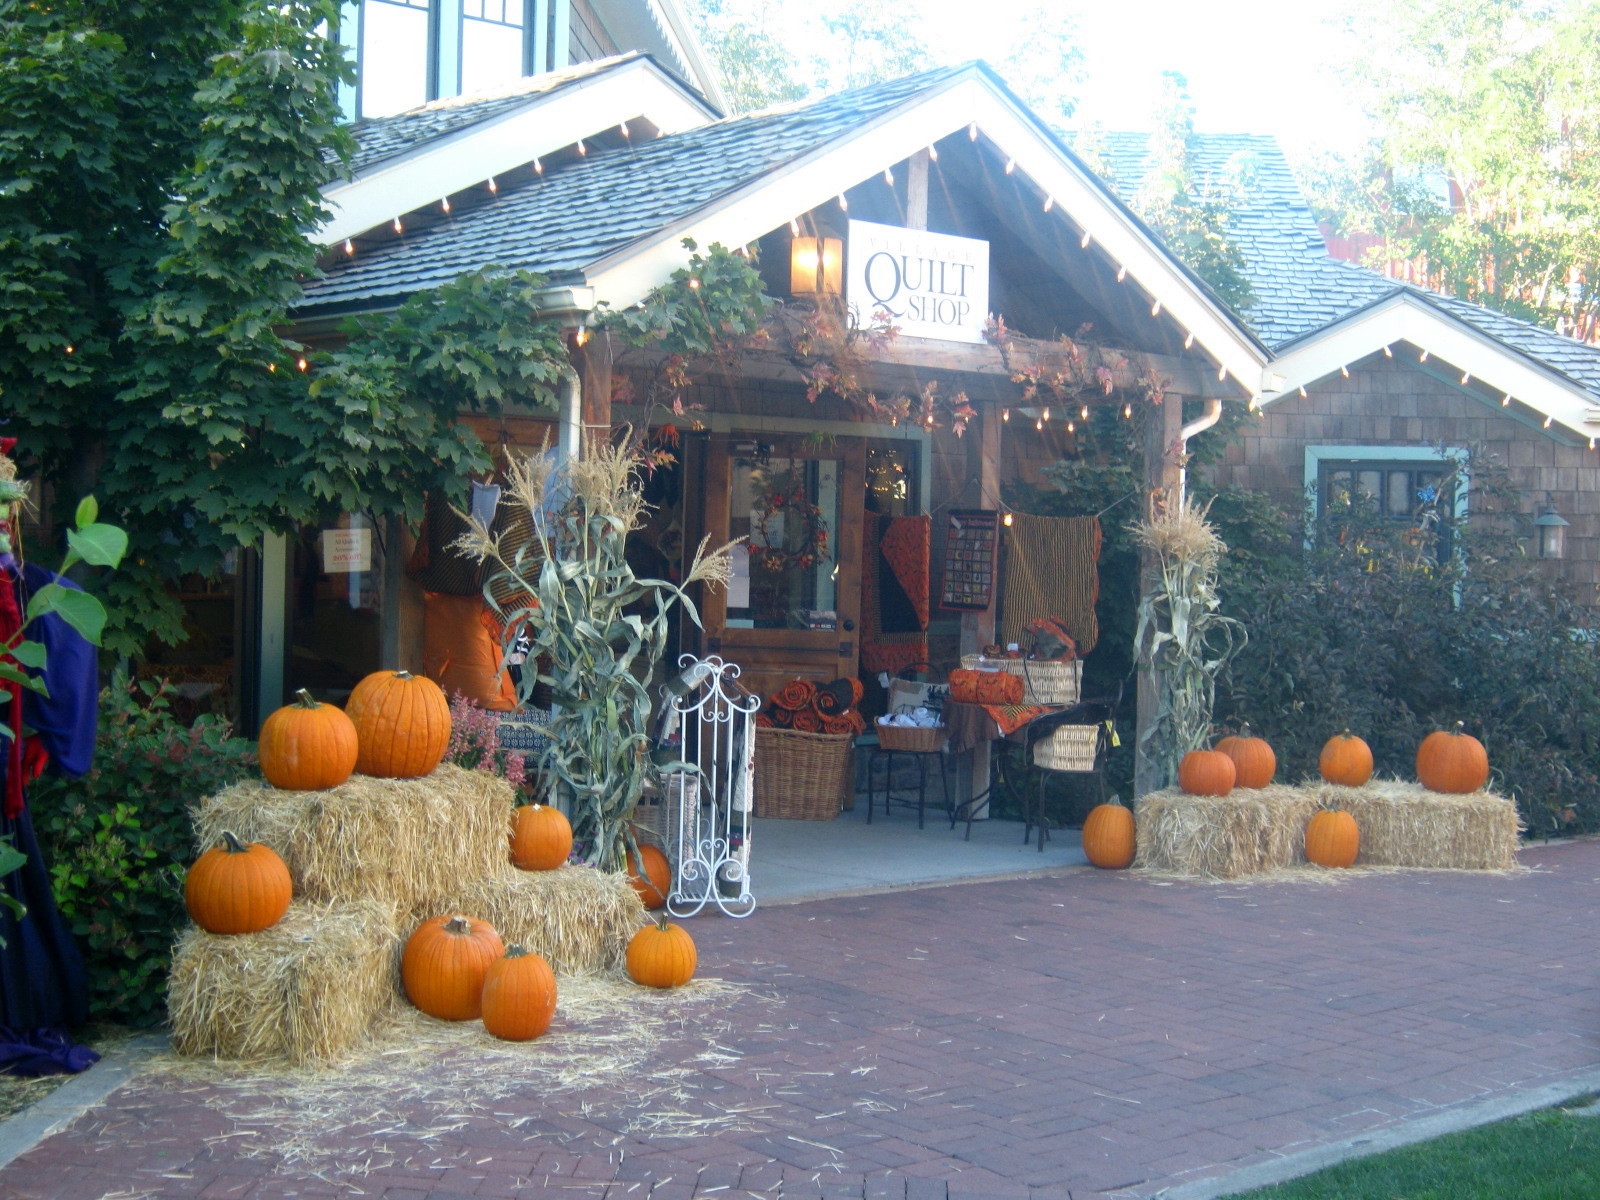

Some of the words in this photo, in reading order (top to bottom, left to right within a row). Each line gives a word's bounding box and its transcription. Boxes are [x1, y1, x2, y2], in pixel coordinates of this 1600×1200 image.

[869, 237, 971, 261] VILLAGE
[865, 252, 974, 317] QUILT
[908, 296, 970, 325] SHOP
